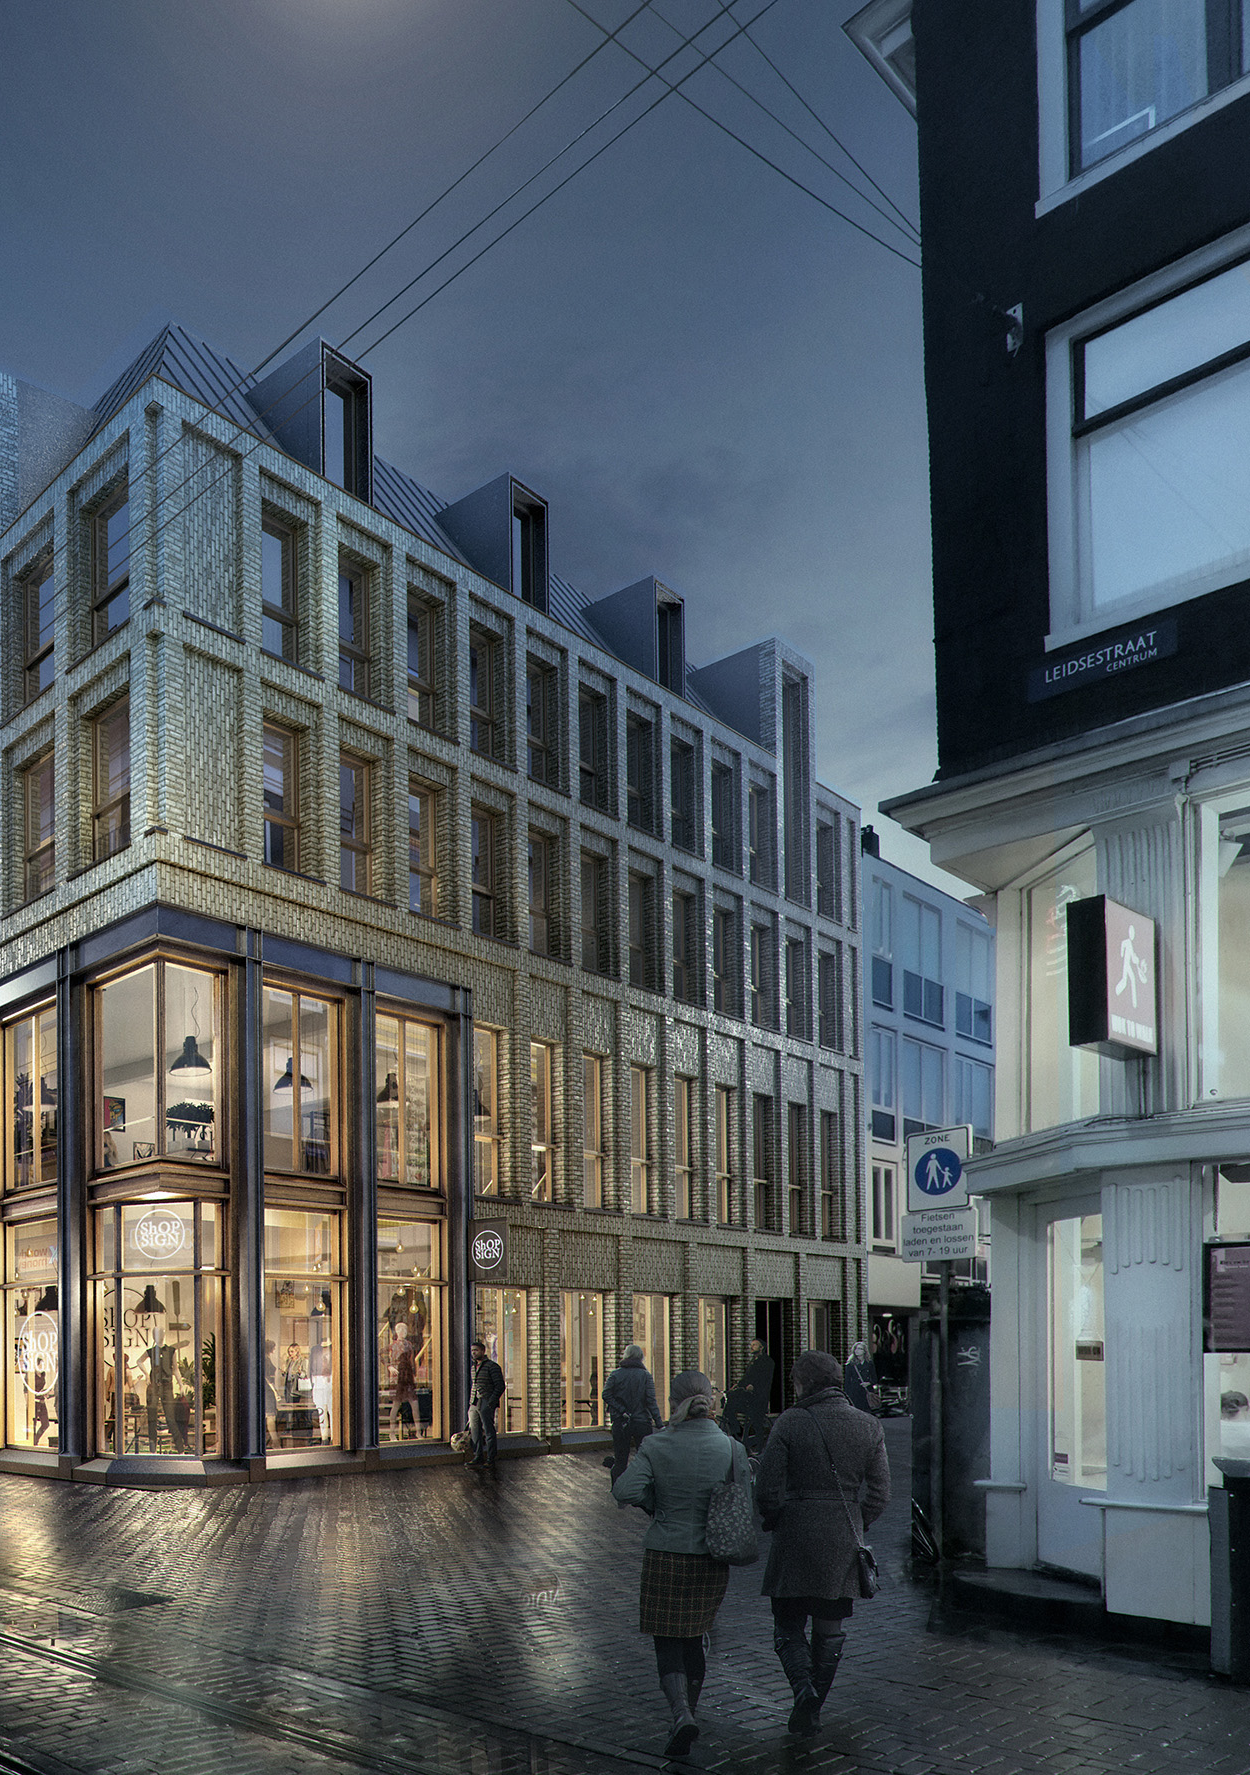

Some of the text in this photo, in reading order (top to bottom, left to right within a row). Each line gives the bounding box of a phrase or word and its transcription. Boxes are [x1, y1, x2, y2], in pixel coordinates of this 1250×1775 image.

[1045, 630, 1158, 684] LEIDSESTRAAT
[1106, 647, 1158, 673] CENTRUM
[924, 1134, 951, 1145] ZONE
[921, 1212, 955, 1222] Fietsen
[912, 1223, 964, 1236] toegestaan
[903, 1238, 928, 1247] laden
[944, 1234, 974, 1243] lossen
[908, 1250, 925, 1258] van
[940, 1246, 950, 1255] 19
[952, 1246, 968, 1254] uur
